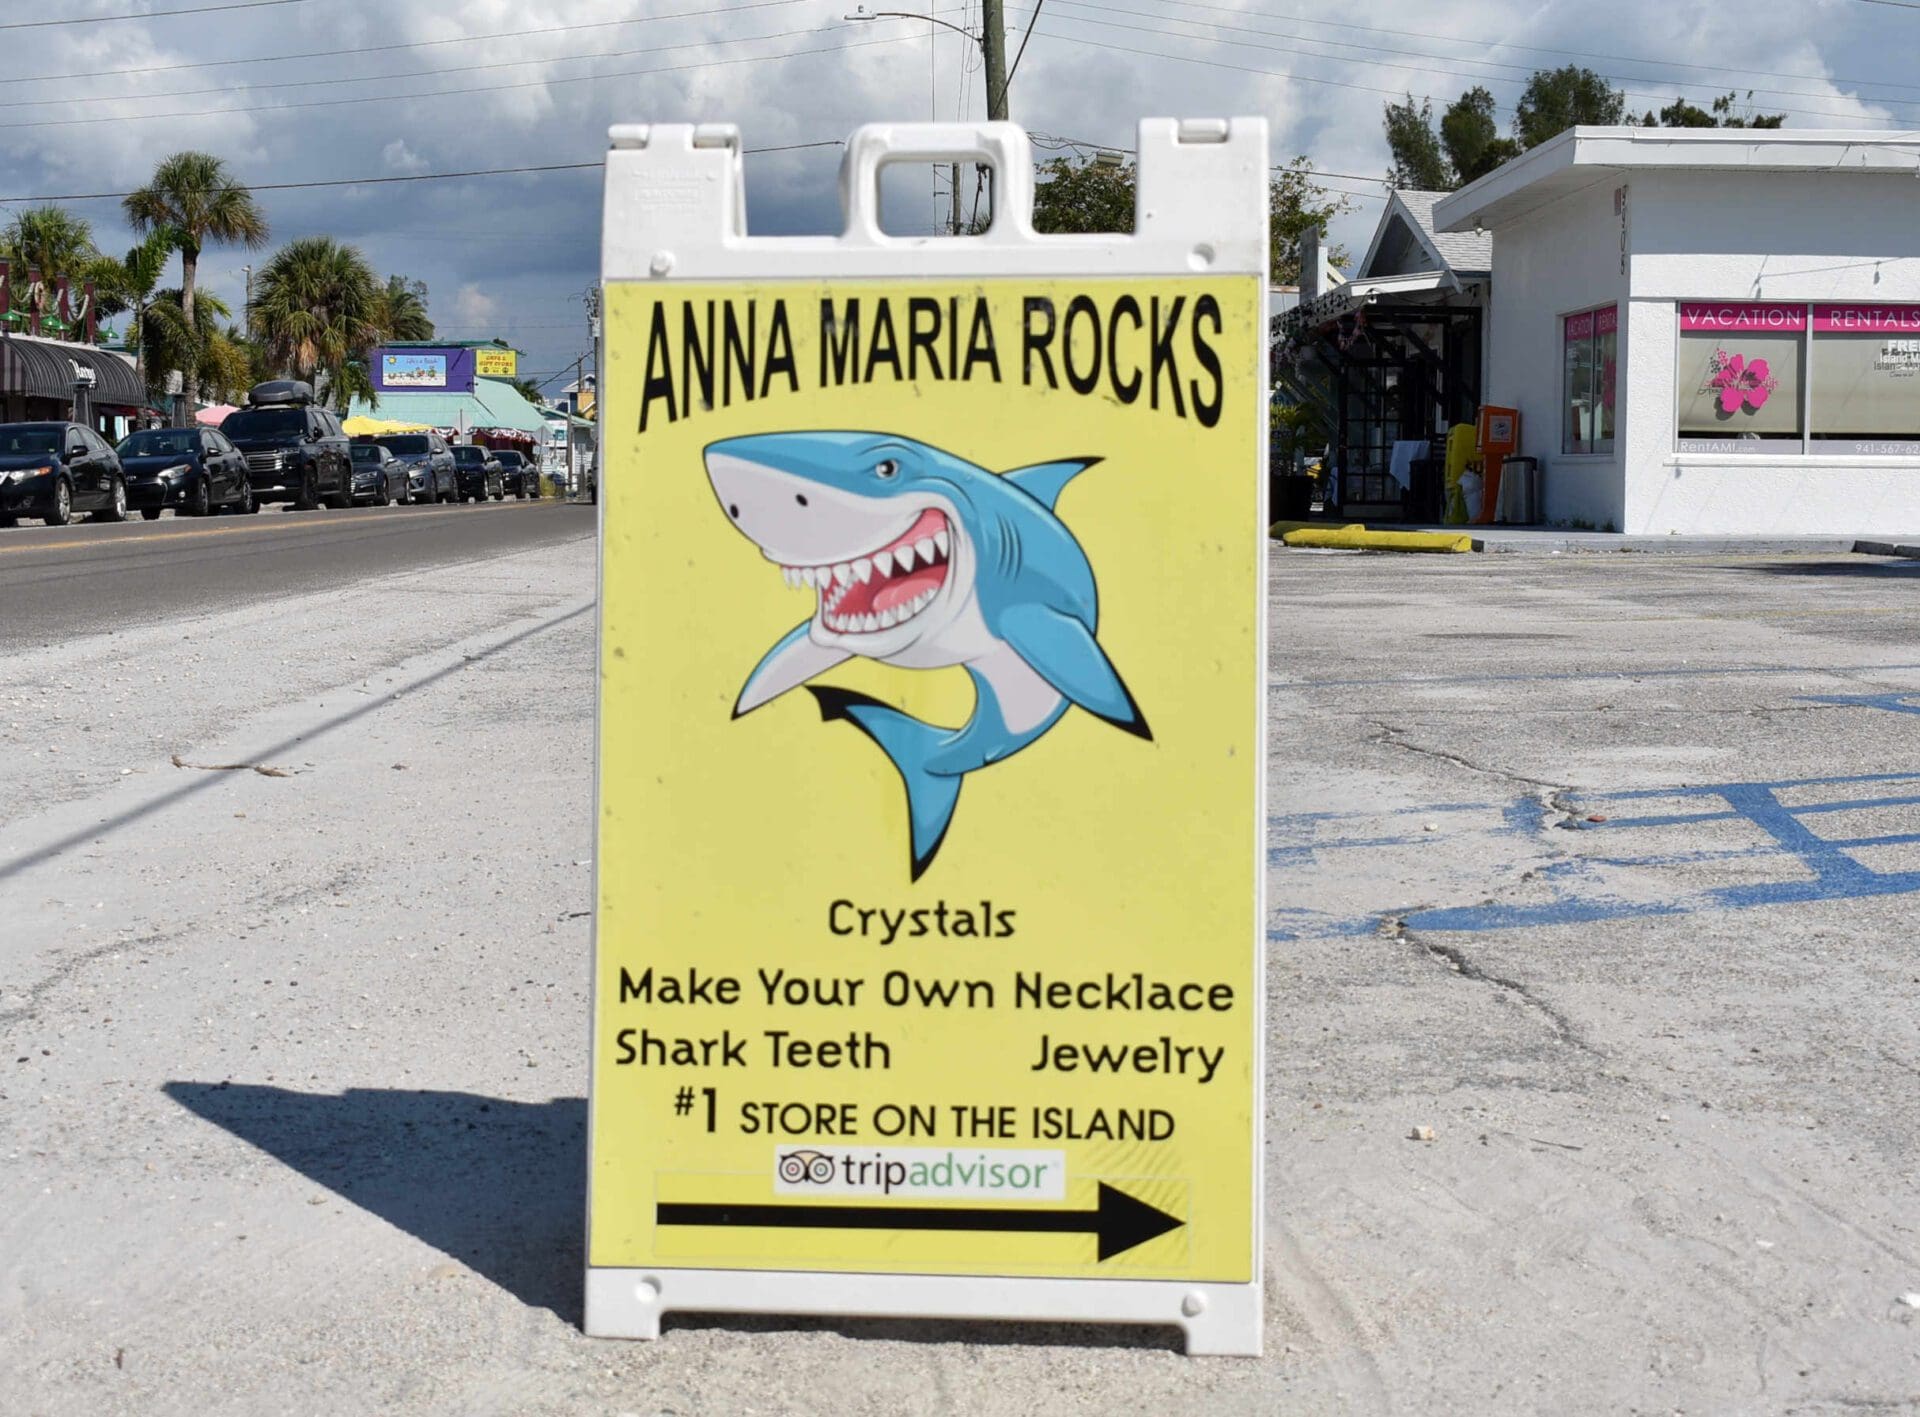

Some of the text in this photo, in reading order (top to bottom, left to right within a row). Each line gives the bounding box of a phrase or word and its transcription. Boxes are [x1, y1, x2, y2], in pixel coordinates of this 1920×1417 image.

[1687, 308, 1920, 328] VACATION RENTALS
[638, 294, 1224, 434] ANNA MARIA ROCKS
[1888, 340, 1920, 352] FRE
[1855, 443, 1920, 454] 941-567-62
[829, 899, 1016, 946] Crystals
[619, 967, 1234, 1012] Make Your Own Necklace
[616, 1028, 890, 1069] Shark Teeth
[1031, 1034, 1225, 1084] Jewelry
[674, 1086, 1175, 1141] #1 STORE ON THE ISLAND
[841, 1152, 1049, 1195] tripadvisor
